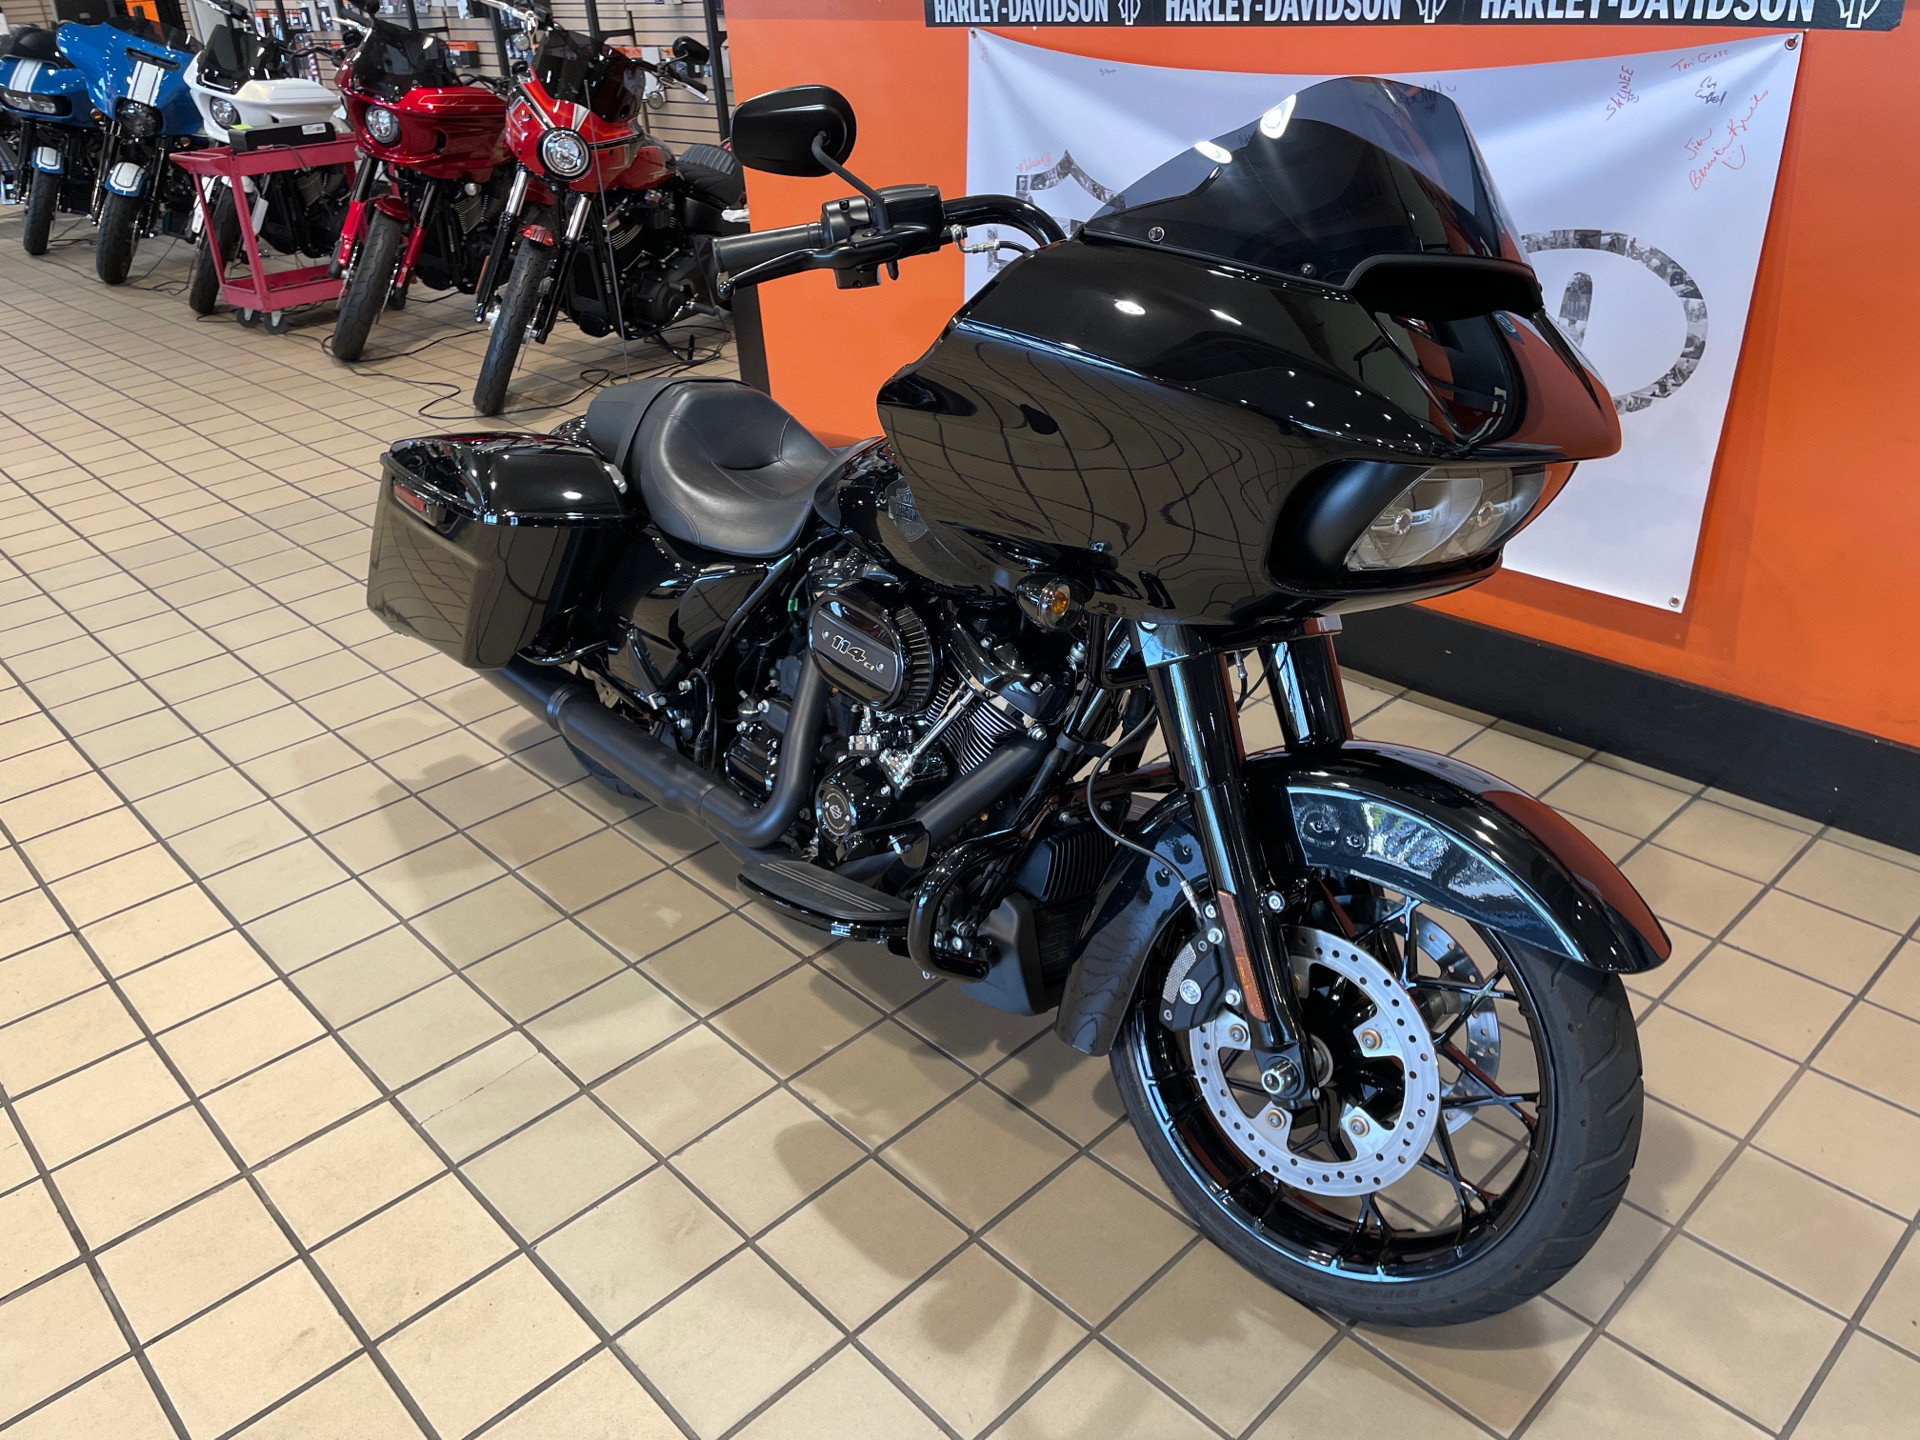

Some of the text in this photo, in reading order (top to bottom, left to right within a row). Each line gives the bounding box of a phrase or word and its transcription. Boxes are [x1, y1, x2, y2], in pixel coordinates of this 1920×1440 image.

[934, 0, 1109, 23] HARLEY-DAVIDSON
[1165, 0, 1401, 22] HARLEY-DAVIDSON
[831, 634, 867, 663] 114
